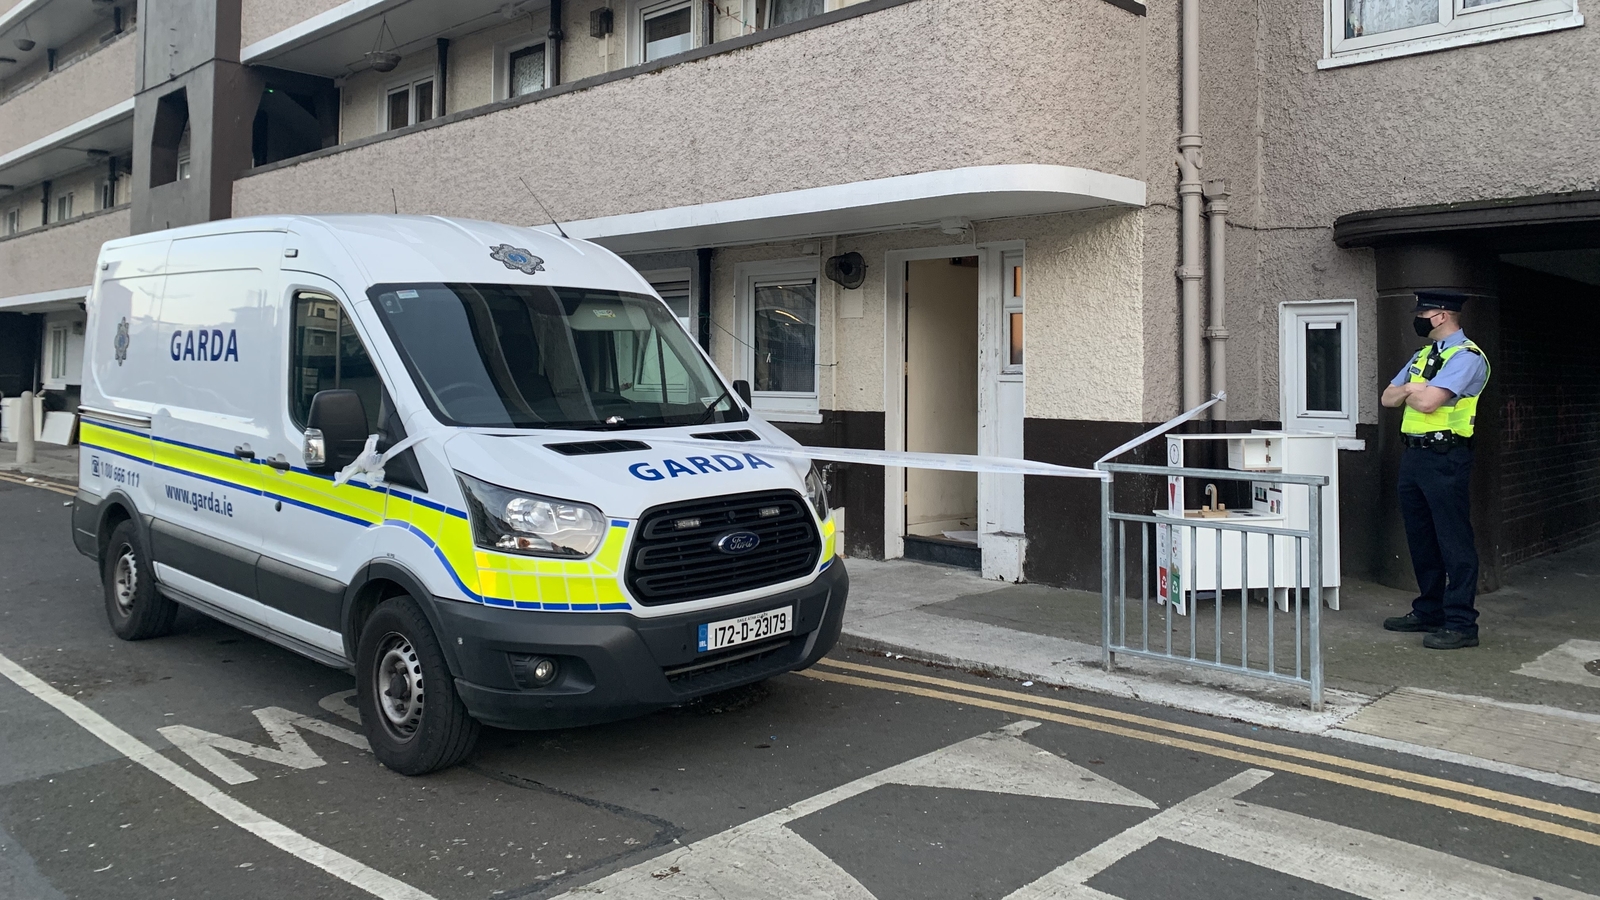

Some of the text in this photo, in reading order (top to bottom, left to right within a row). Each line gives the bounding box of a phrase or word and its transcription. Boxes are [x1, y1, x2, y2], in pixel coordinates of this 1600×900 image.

[170, 329, 239, 362] GARDA
[114, 466, 125, 483] 666
[127, 471, 140, 488] 111
[628, 453, 775, 482] GARDA
[165, 484, 233, 518] www.garda.ie
[730, 536, 753, 550] Ford
[714, 612, 786, 647] 172-D-23179
